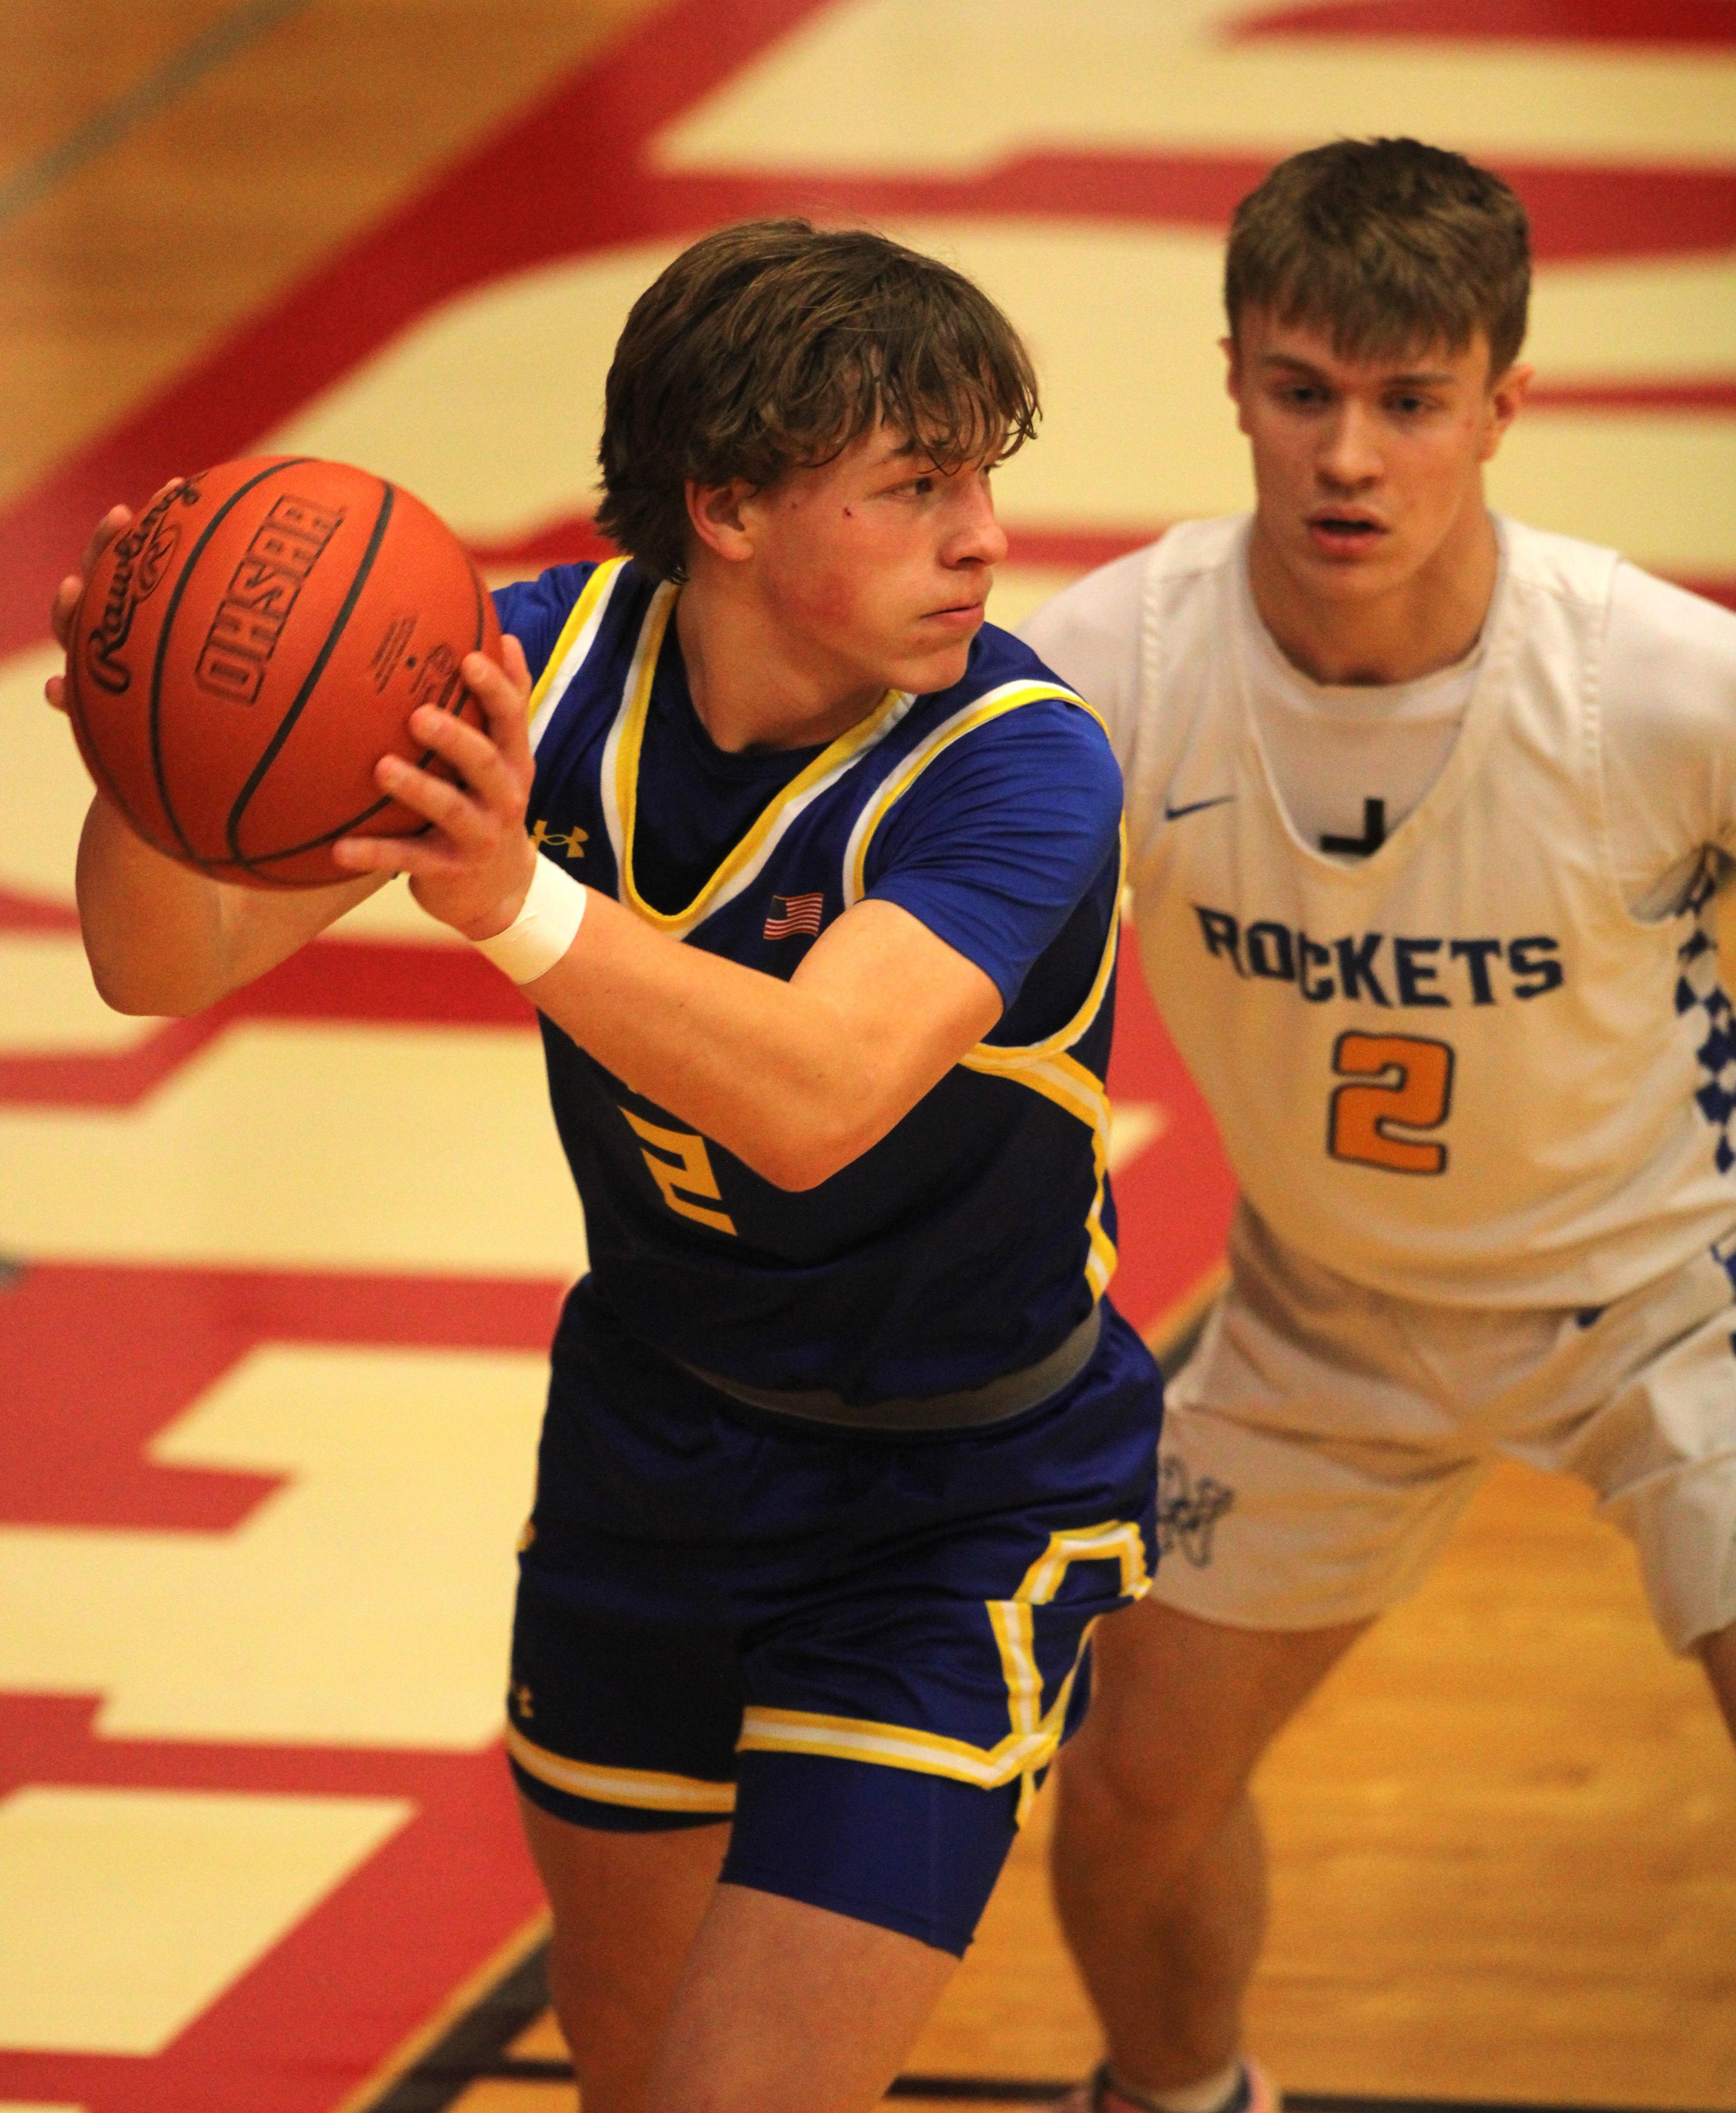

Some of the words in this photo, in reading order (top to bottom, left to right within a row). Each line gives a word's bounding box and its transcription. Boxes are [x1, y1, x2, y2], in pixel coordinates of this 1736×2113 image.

[196, 494, 347, 705] OHSAA
[1192, 902, 1563, 1007] ROCKETS
[617, 1105, 738, 1236] 2
[1327, 1029, 1454, 1176] 2
